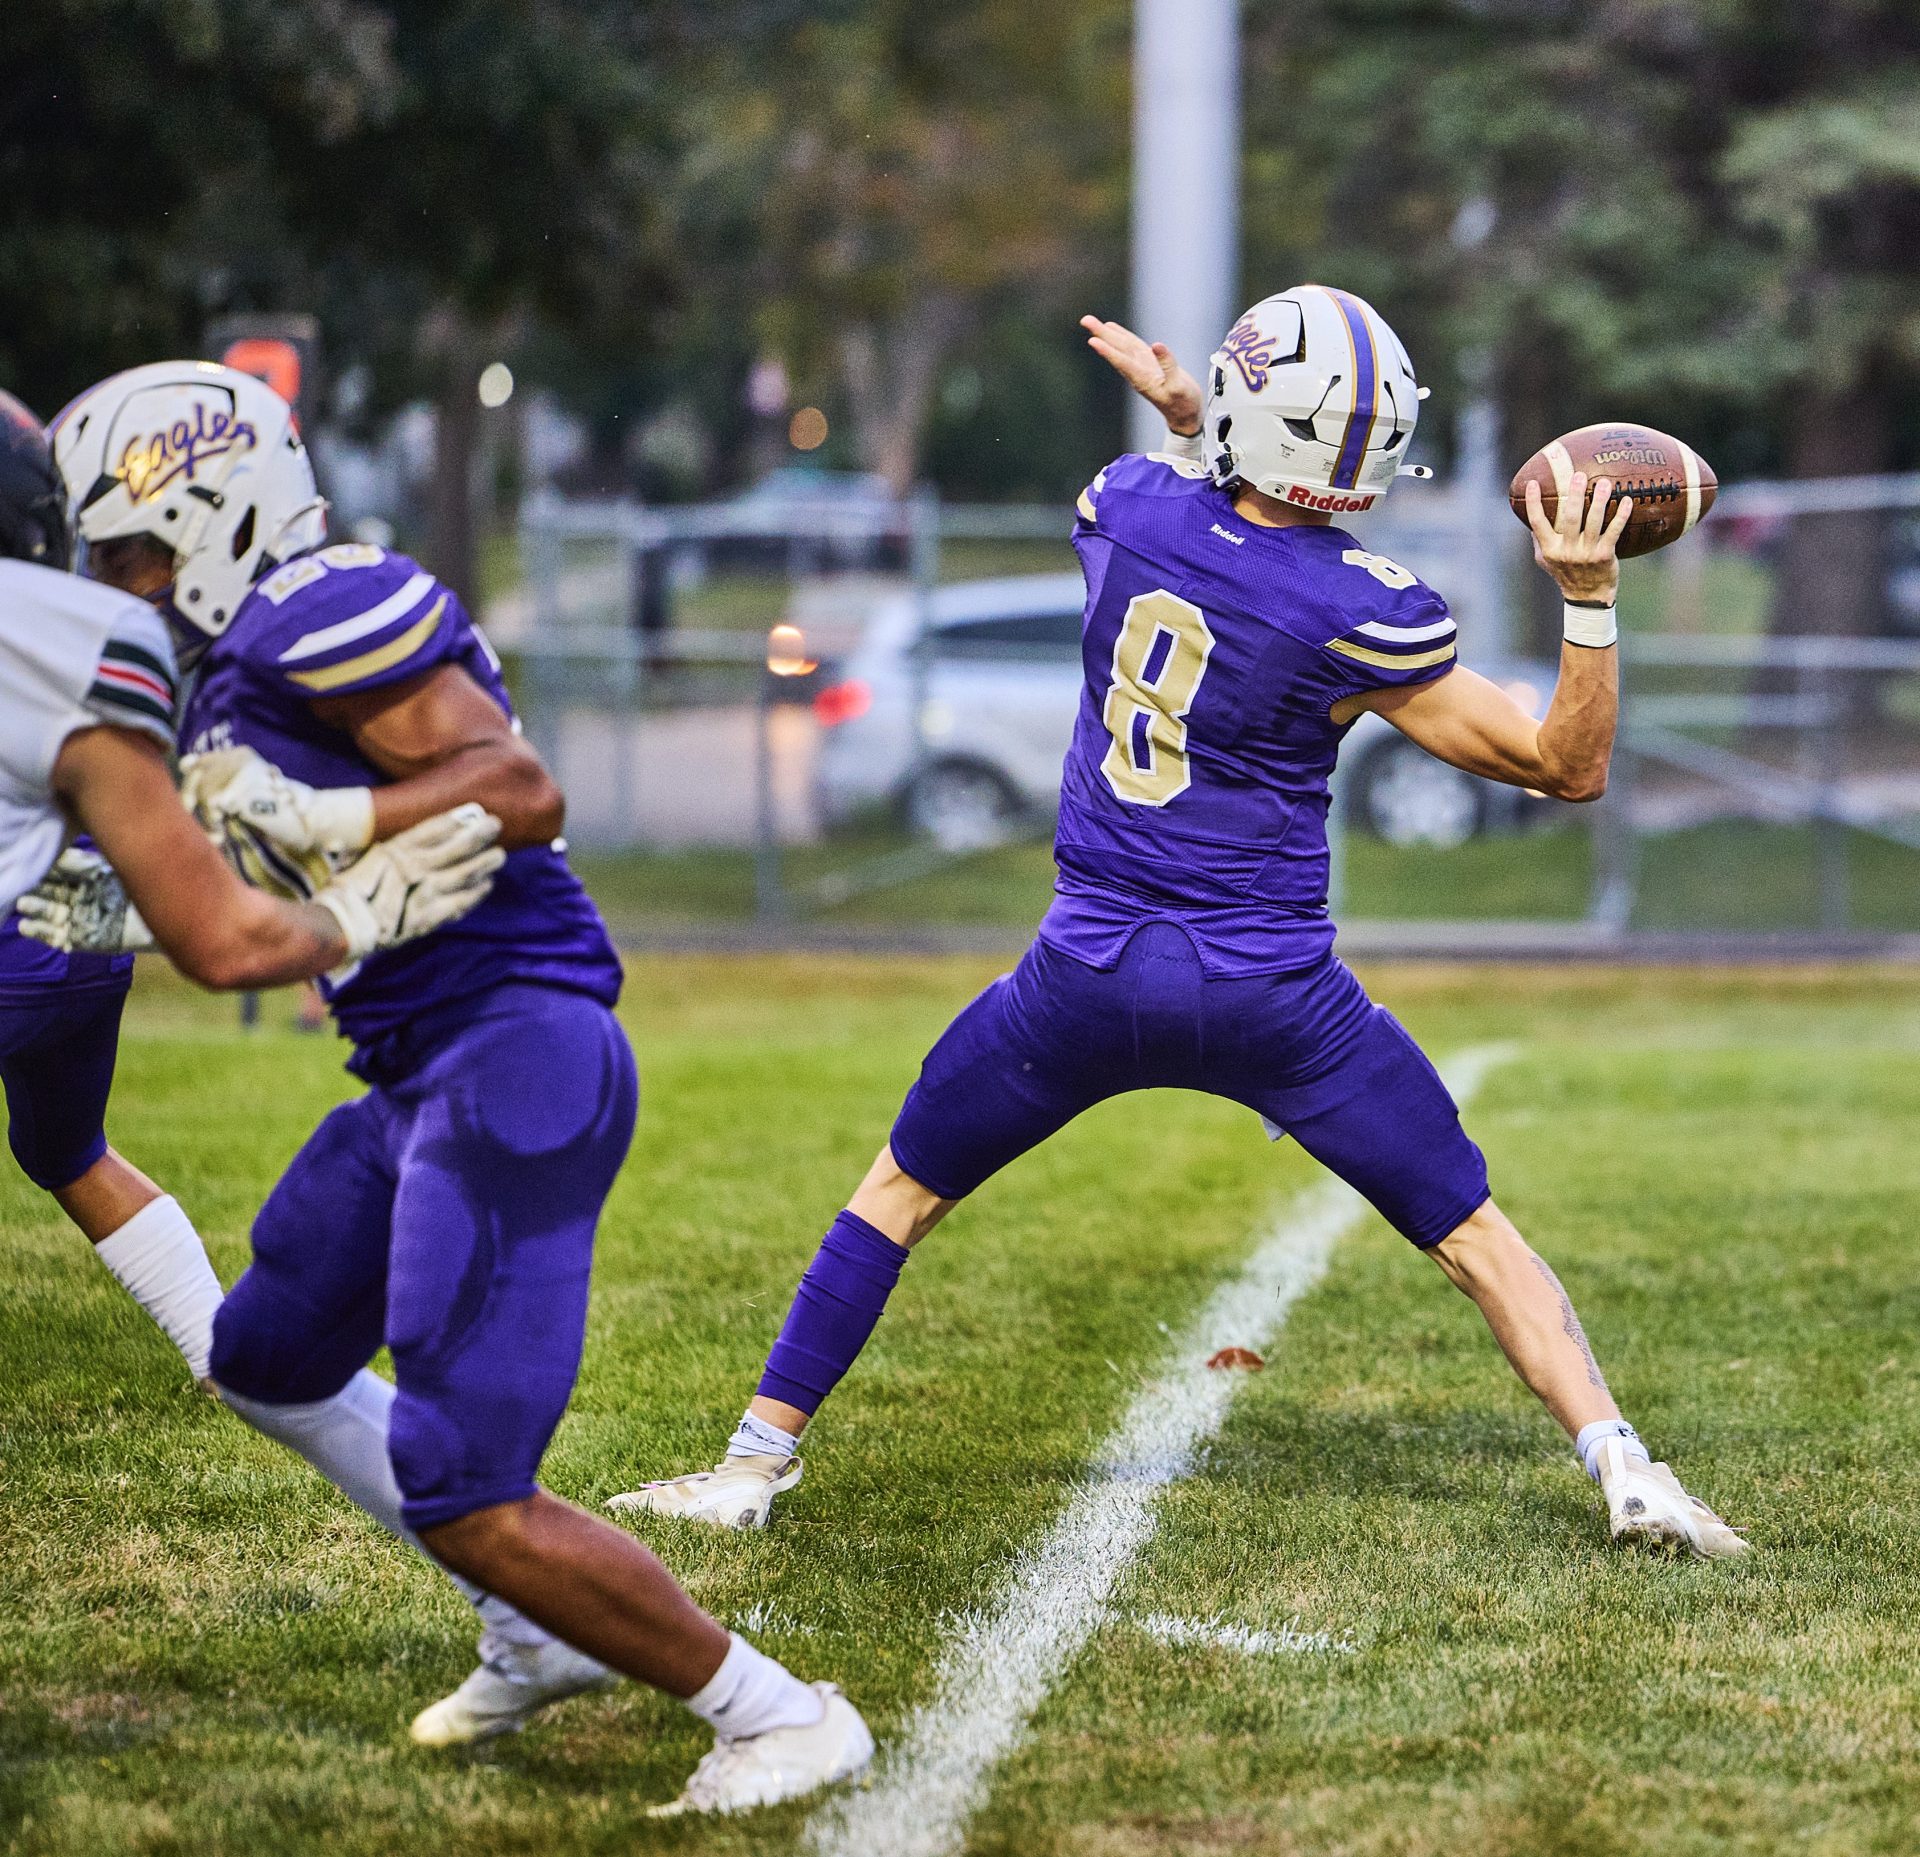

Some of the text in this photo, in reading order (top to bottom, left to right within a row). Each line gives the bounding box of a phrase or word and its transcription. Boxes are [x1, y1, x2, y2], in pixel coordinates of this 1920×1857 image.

[116, 402, 257, 505] Eagles
[1592, 448, 1667, 466] Wilson
[1287, 484, 1376, 512] Riddell
[1210, 523, 1245, 546] Riddell
[1342, 549, 1418, 590] 8
[1100, 588, 1216, 807] 8
